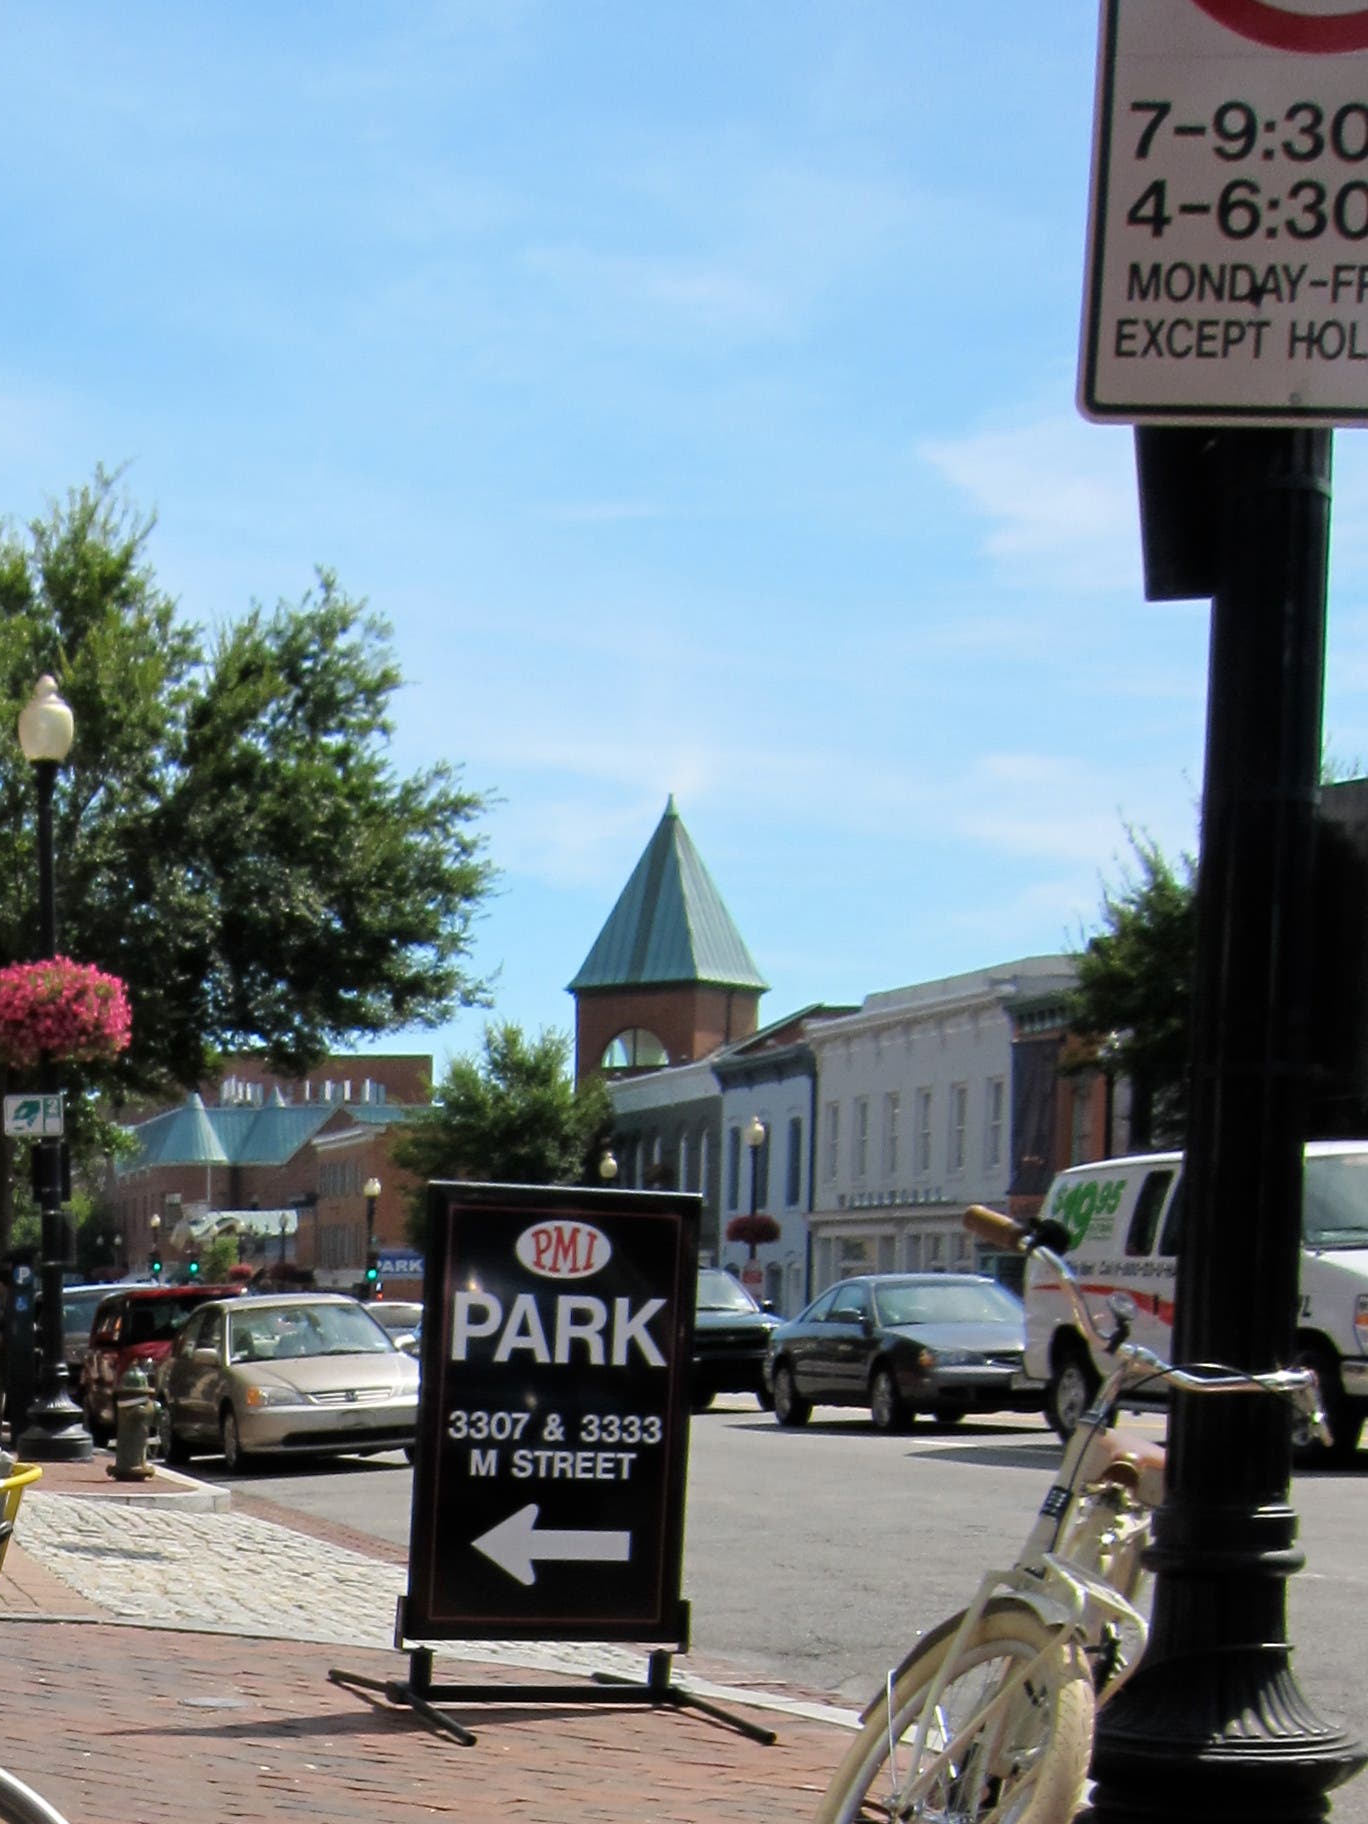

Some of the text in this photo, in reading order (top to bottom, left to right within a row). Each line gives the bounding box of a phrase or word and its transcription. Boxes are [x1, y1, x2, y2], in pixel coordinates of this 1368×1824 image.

[1130, 101, 1368, 162] 7-9:30
[1126, 178, 1368, 241] 4-6:30
[1114, 317, 1271, 360] EXCEPT
[531, 1226, 598, 1273] PMI
[451, 1290, 667, 1367] PARK
[448, 1410, 662, 1444] 3307 & 3333
[469, 1449, 638, 1480] M STREET
